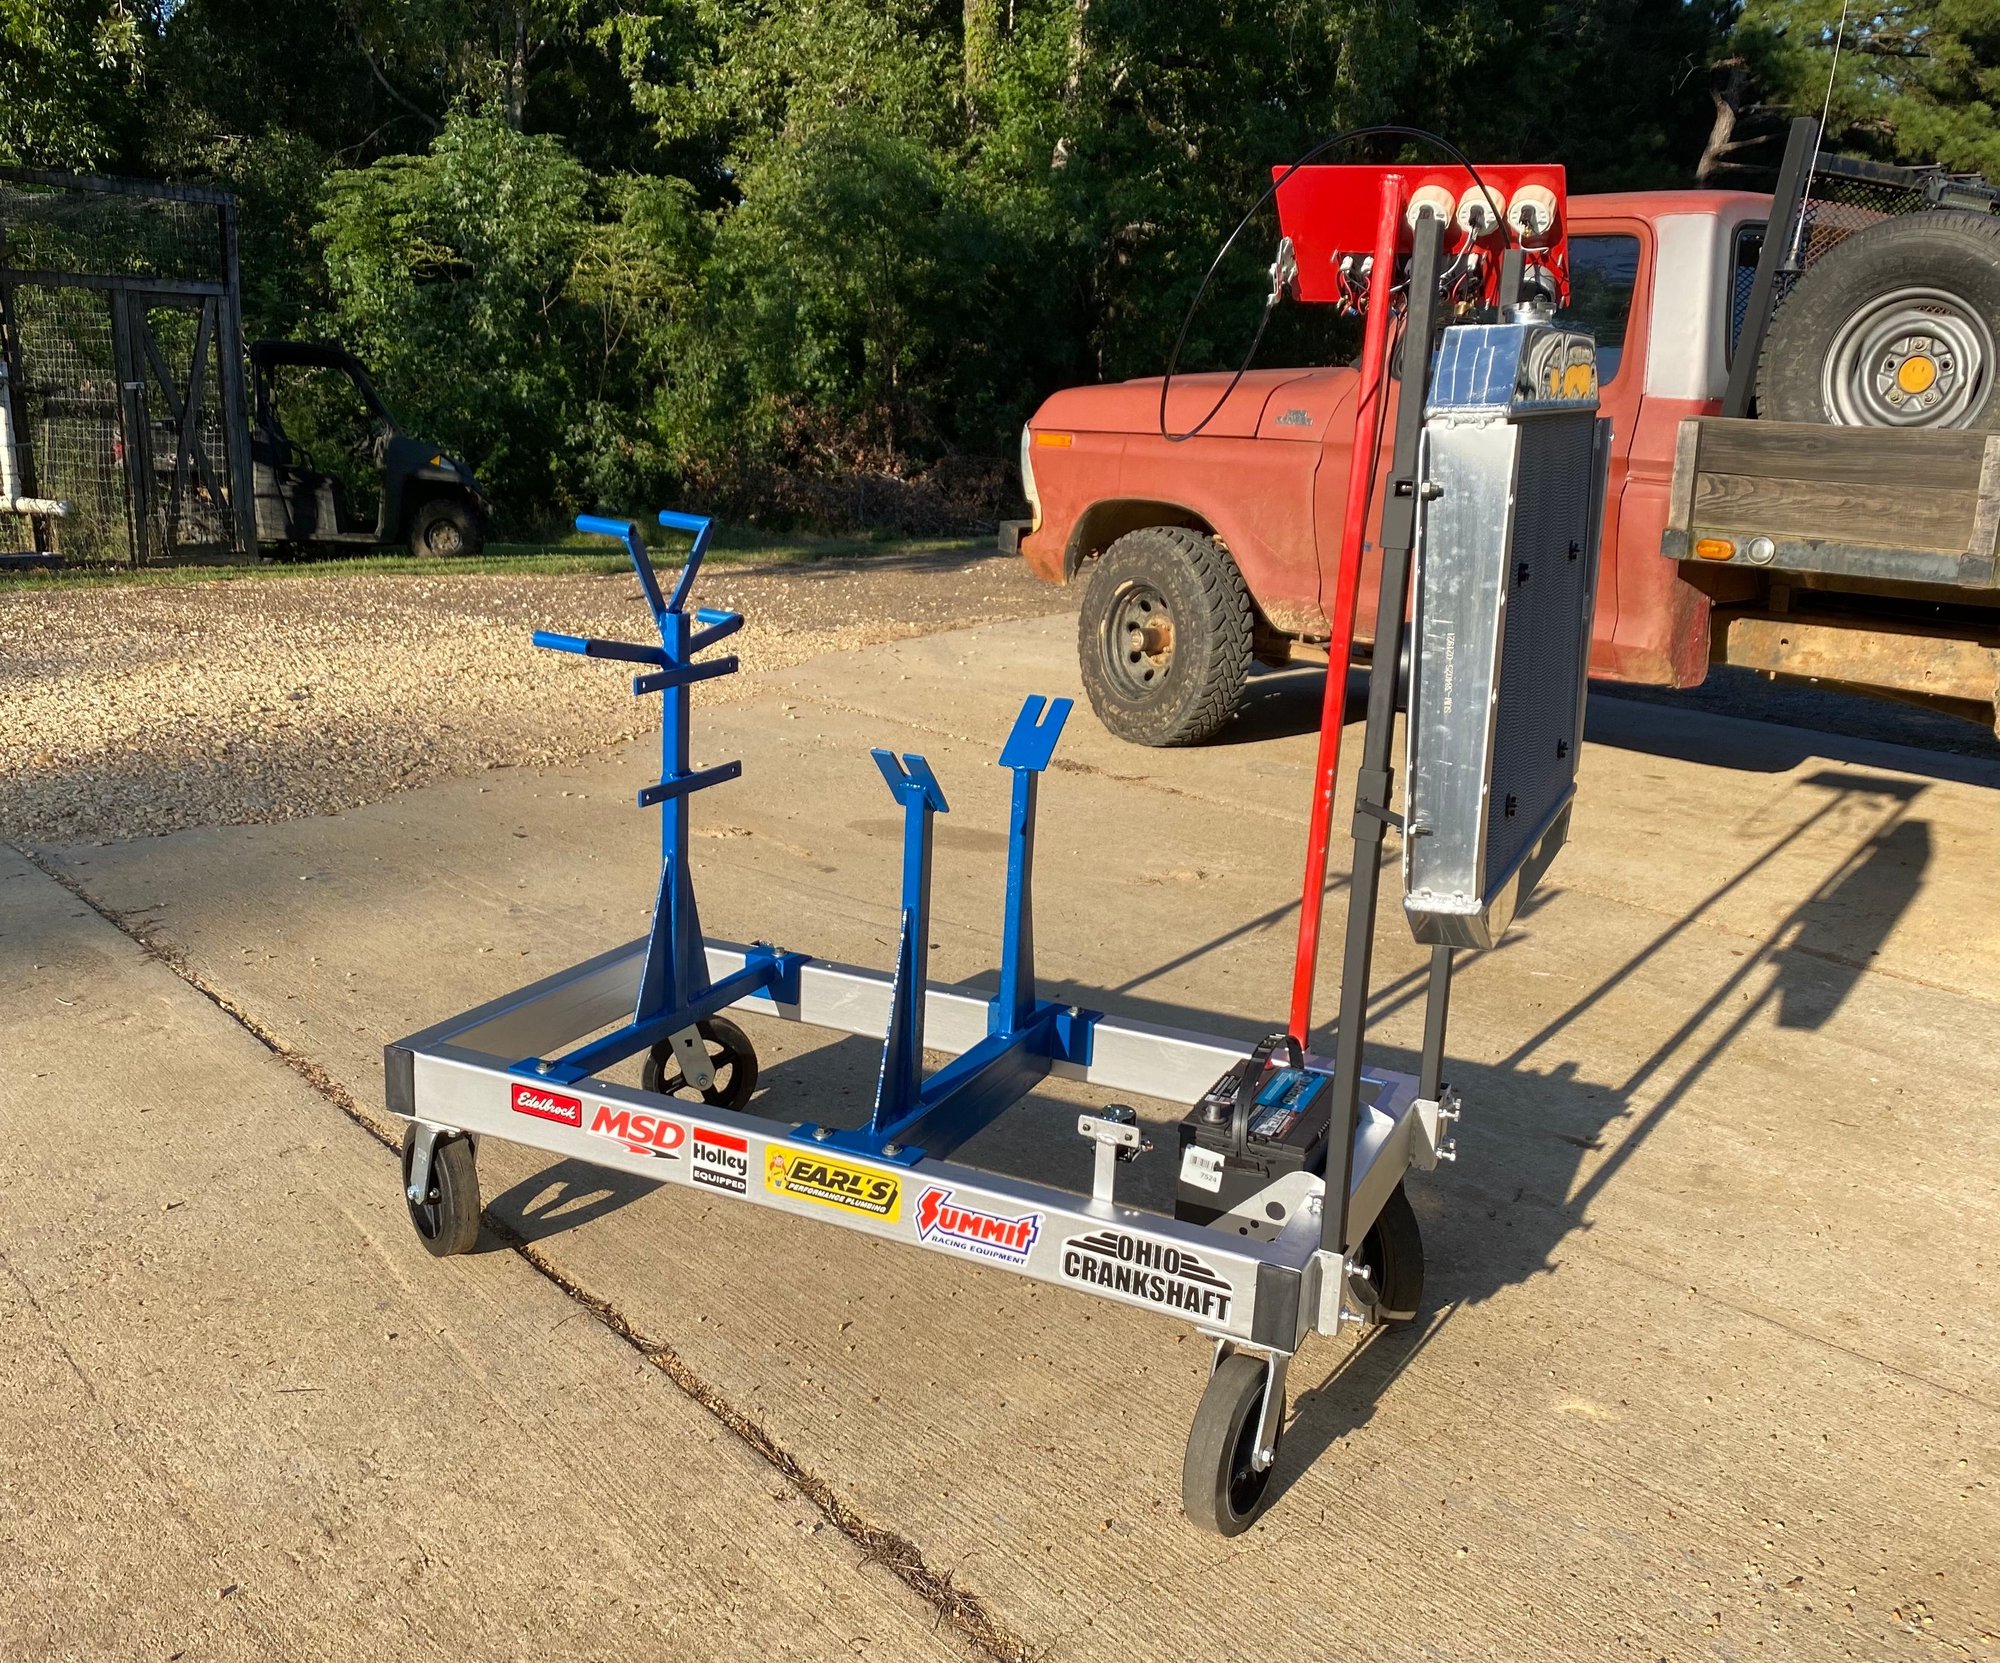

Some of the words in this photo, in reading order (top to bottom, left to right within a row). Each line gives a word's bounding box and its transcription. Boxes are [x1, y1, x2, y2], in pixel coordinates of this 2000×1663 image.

[517, 1091, 577, 1120] Edelbrock
[590, 1106, 686, 1149] MSD
[693, 1143, 748, 1176] Holley
[693, 1169, 746, 1191] EQUIPPED
[790, 1160, 892, 1201] EARL'S
[788, 1182, 845, 1204] PERFORMANCE
[845, 1197, 887, 1214] PLUMBING
[931, 1235, 967, 1250] RACING
[969, 1245, 1026, 1266] EQUIPMENT
[1117, 1235, 1181, 1275] OHIO
[1064, 1251, 1231, 1321] CRANKSHAFT
